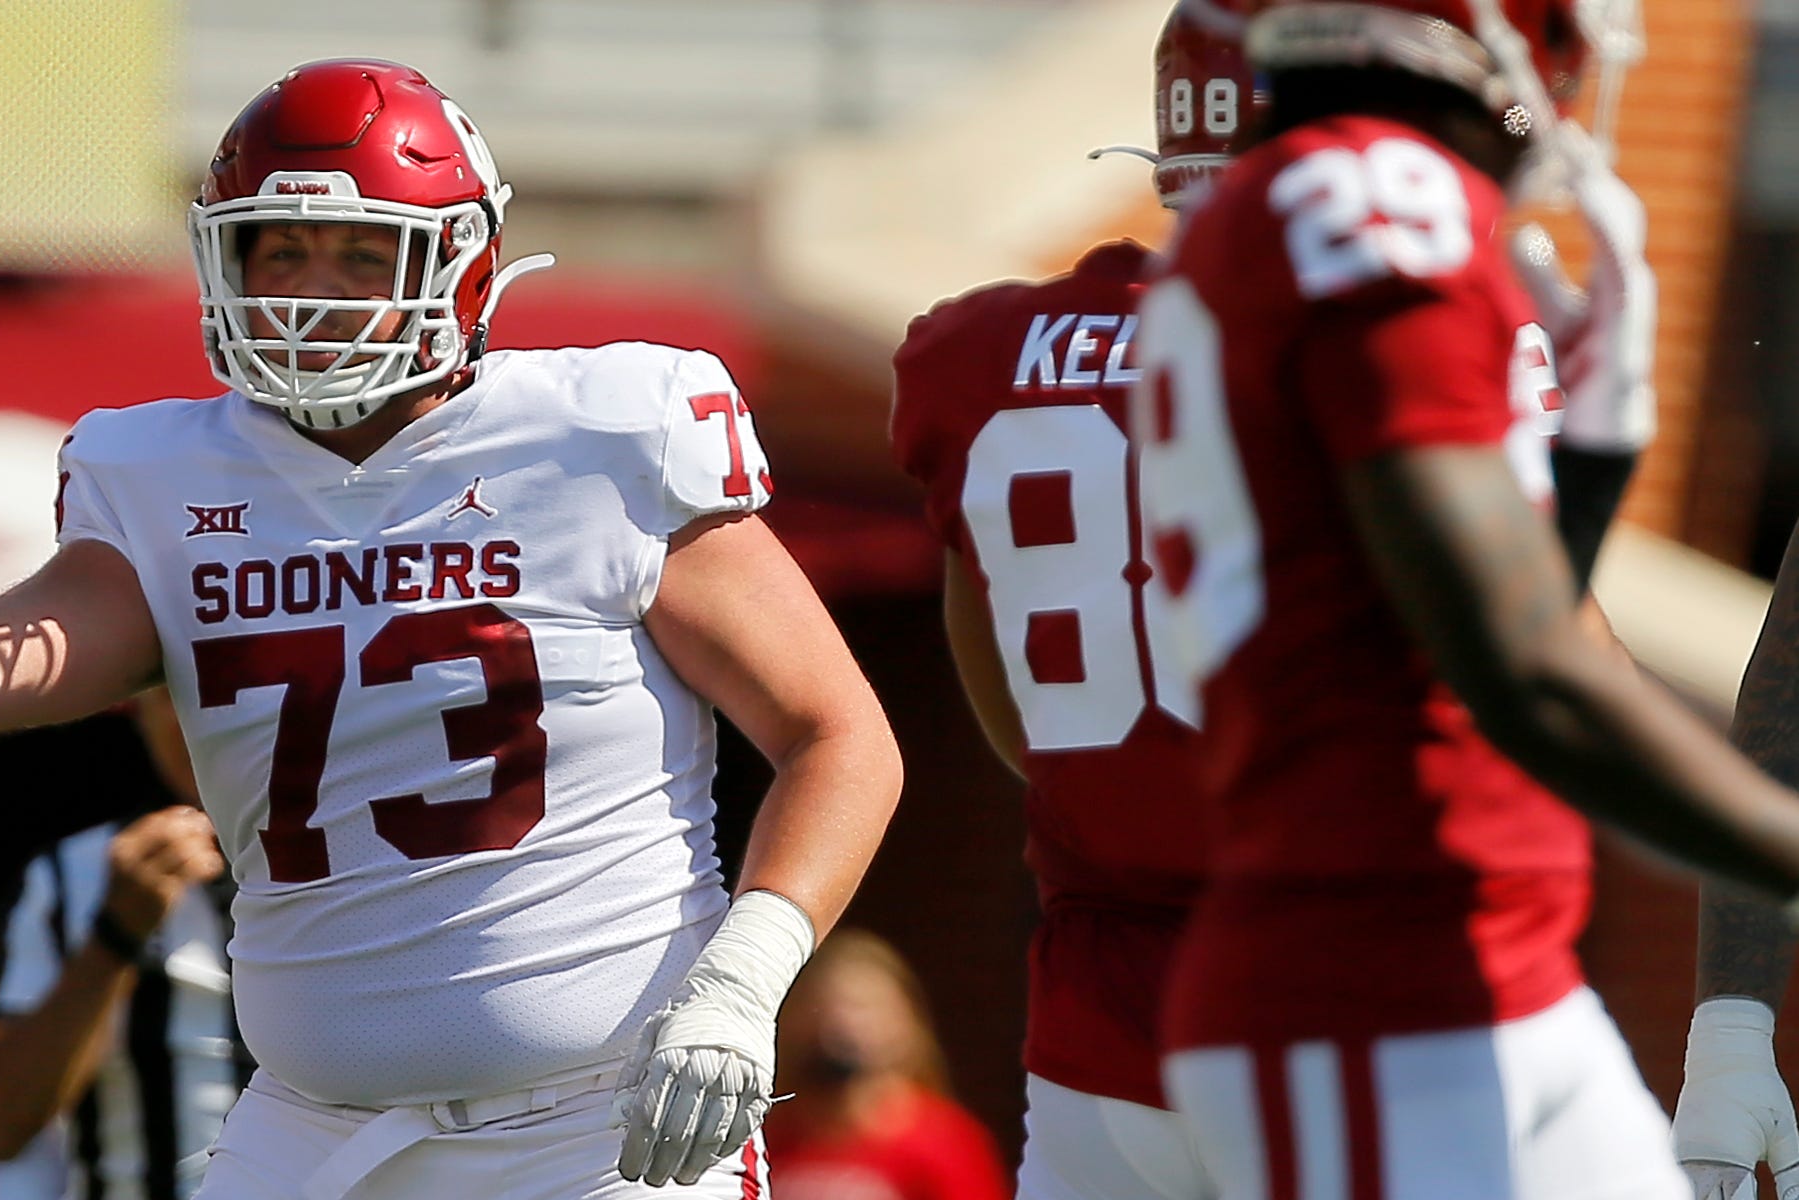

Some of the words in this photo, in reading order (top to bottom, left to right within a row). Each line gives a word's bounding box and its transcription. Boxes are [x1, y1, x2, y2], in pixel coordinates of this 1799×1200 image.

[1170, 78, 1238, 134] 88
[1267, 137, 1473, 300] 29
[687, 391, 775, 498] 7
[185, 502, 250, 538] XII
[192, 540, 521, 625] SOONERS
[192, 602, 547, 884] 73
